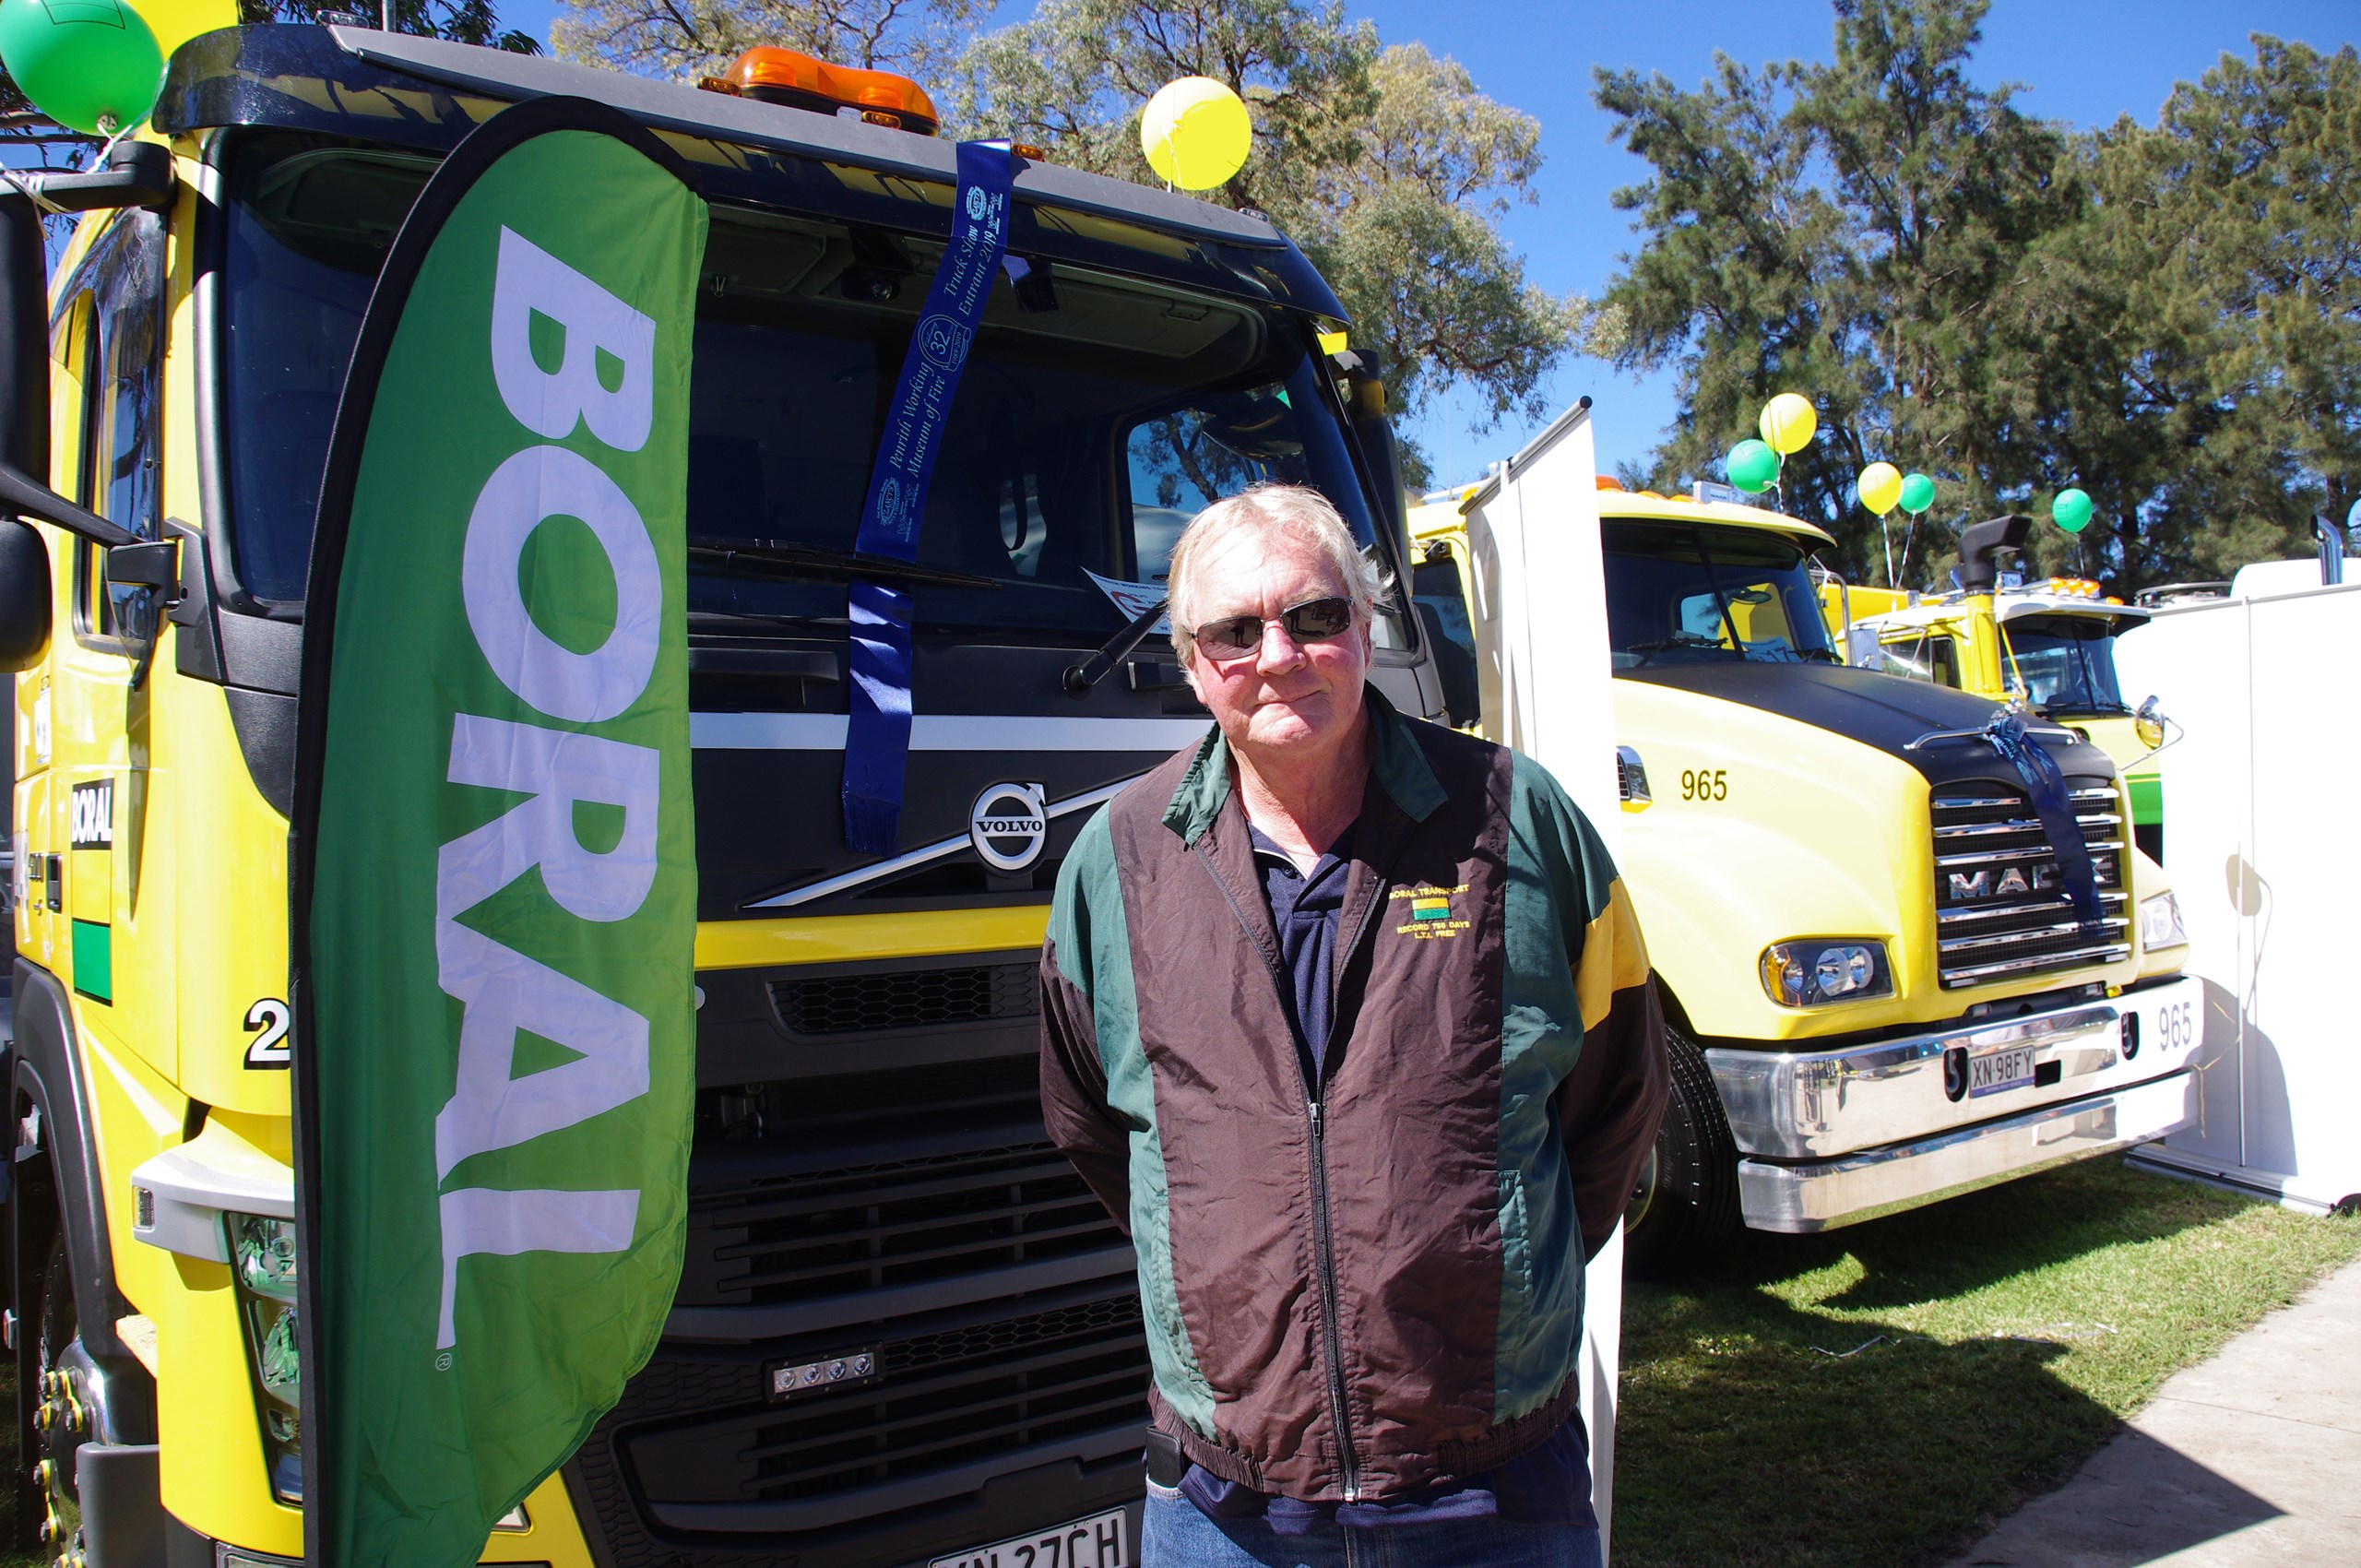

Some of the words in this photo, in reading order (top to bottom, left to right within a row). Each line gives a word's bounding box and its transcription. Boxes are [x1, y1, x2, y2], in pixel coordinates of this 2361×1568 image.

[943, 255, 967, 297] Truck
[961, 225, 979, 258] Show
[958, 262, 987, 317] Entrant
[979, 230, 996, 263] 2019
[930, 330, 951, 355] 32
[951, 331, 962, 365] 1988-2019
[928, 375, 945, 403] Fire
[889, 419, 912, 469] Penrith
[903, 362, 934, 417] Working
[923, 398, 941, 422] of
[908, 421, 932, 479] Museum
[435, 223, 663, 1349] BORAL
[1681, 769, 1727, 801] 965
[71, 786, 113, 844] BORAL
[976, 820, 1043, 833] VOLVO
[1389, 889, 1418, 900] BORAL
[1418, 884, 1470, 896] TRANSPORT
[1396, 923, 1430, 934] RECORD
[1449, 921, 1471, 929] DAYS
[1435, 929, 1456, 938] FREE
[2159, 1002, 2192, 1051] 965
